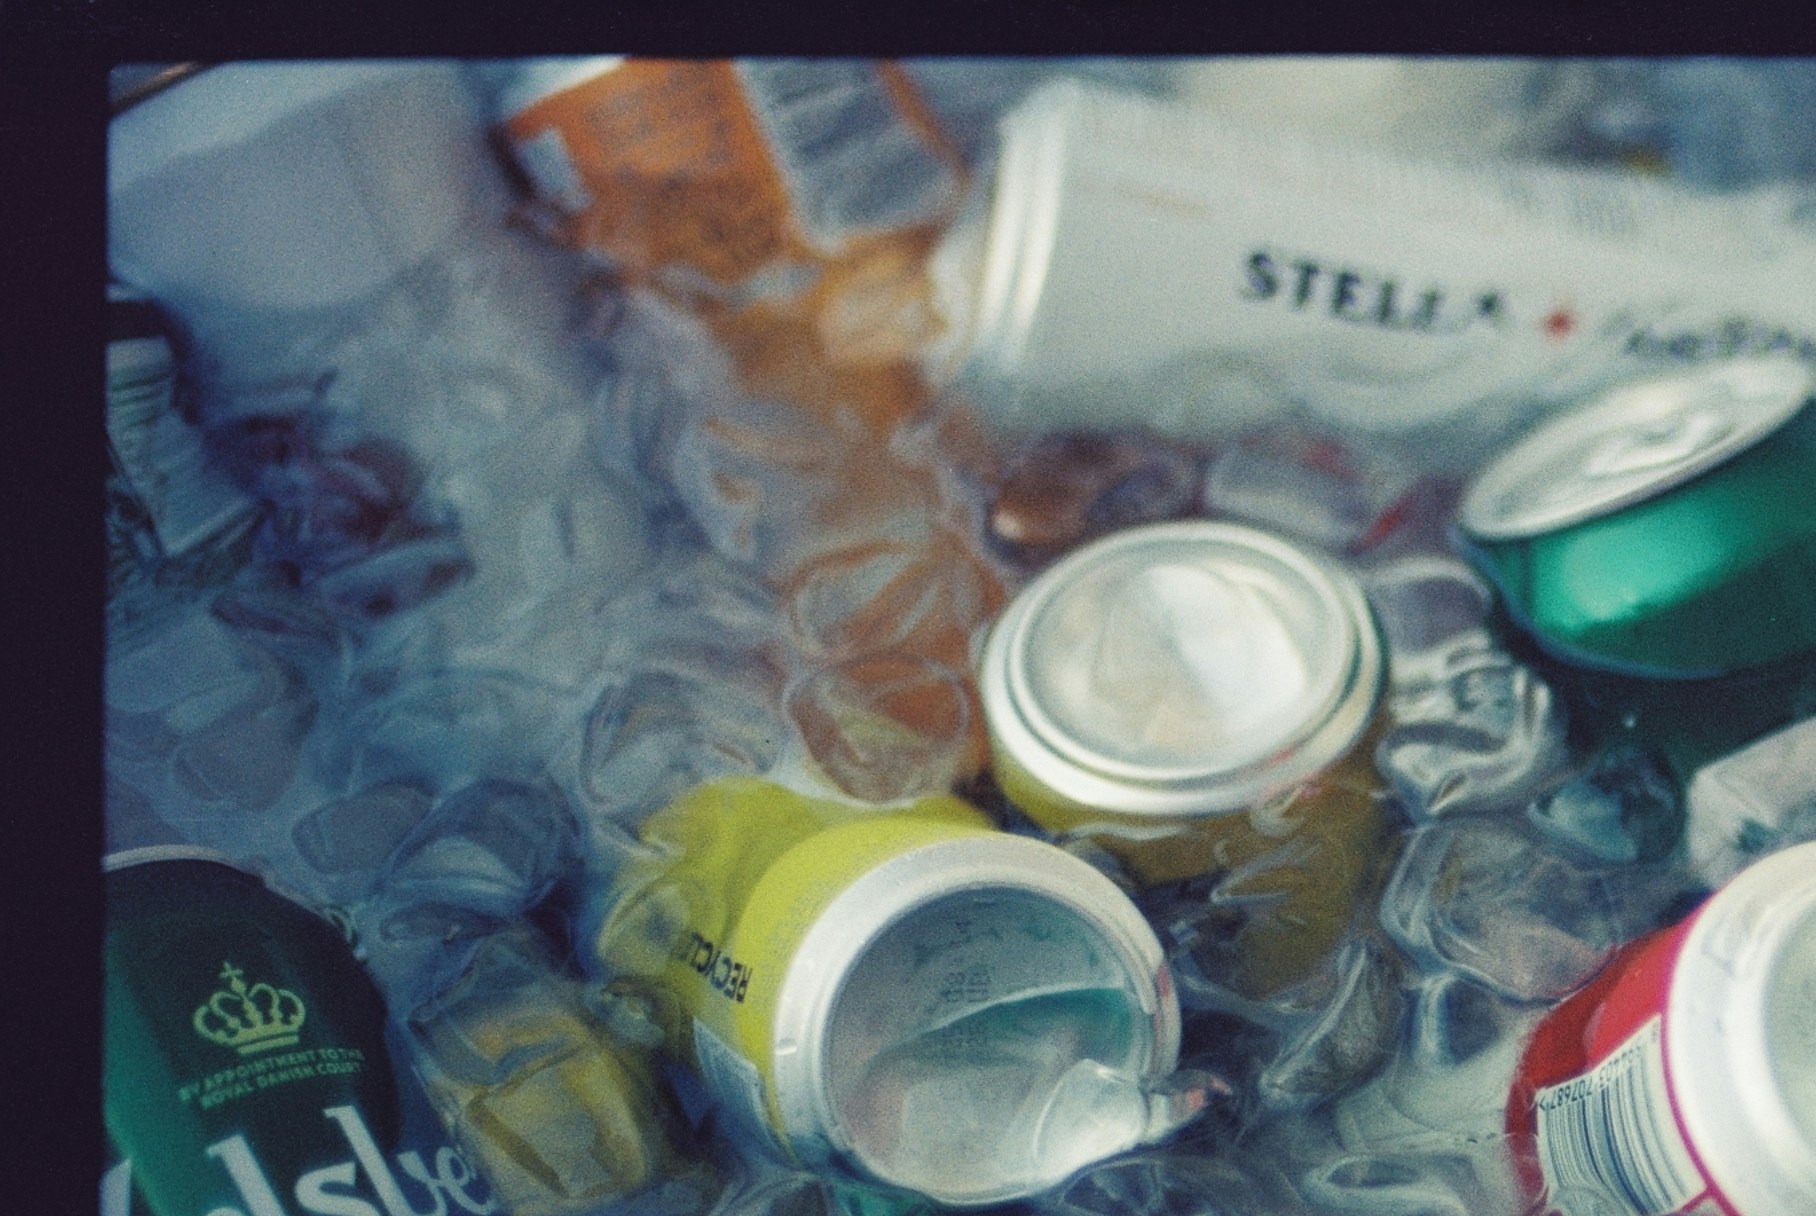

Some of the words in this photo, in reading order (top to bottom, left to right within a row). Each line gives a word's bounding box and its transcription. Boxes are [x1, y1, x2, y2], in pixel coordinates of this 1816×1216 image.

[204, 1050, 315, 1091] APPOINTMENT
[318, 1048, 340, 1060] TO
[256, 1065, 315, 1089] DANISH
